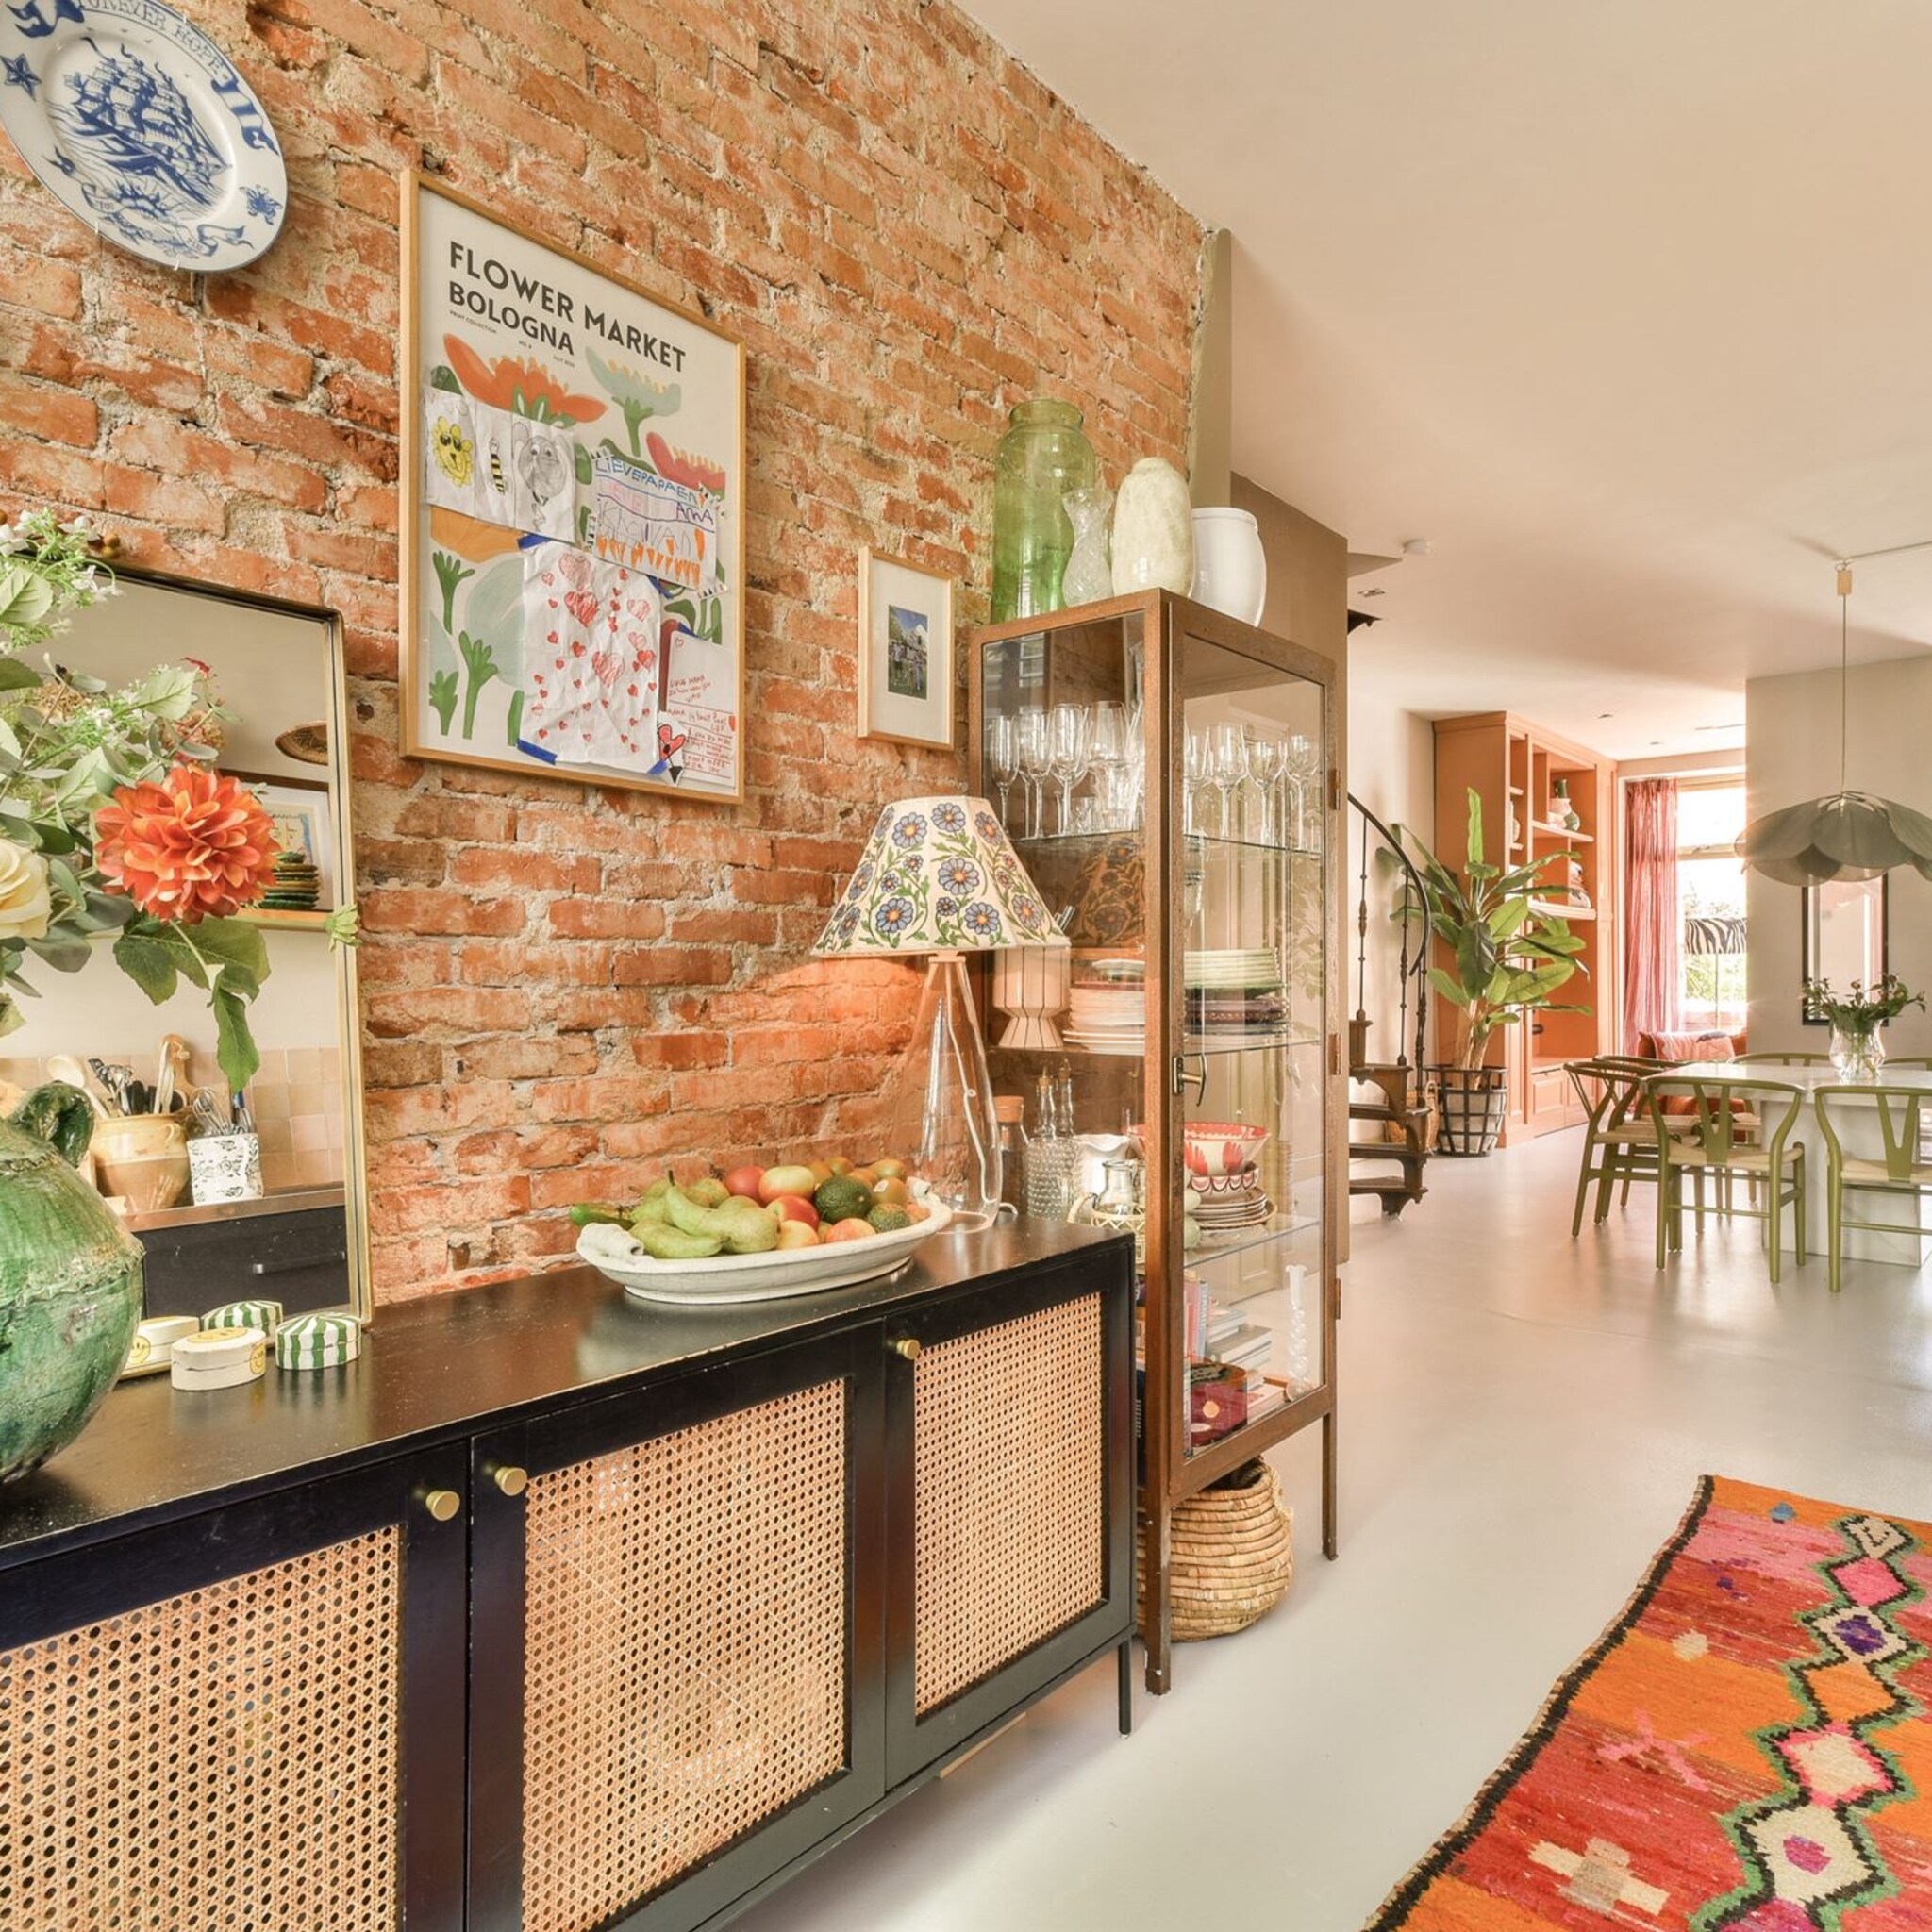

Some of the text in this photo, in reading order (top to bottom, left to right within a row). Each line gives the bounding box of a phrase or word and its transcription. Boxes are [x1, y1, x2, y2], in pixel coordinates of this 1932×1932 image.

[448, 281, 575, 356] BOLOGNA
[449, 240, 686, 372] FLOWER MARKET
